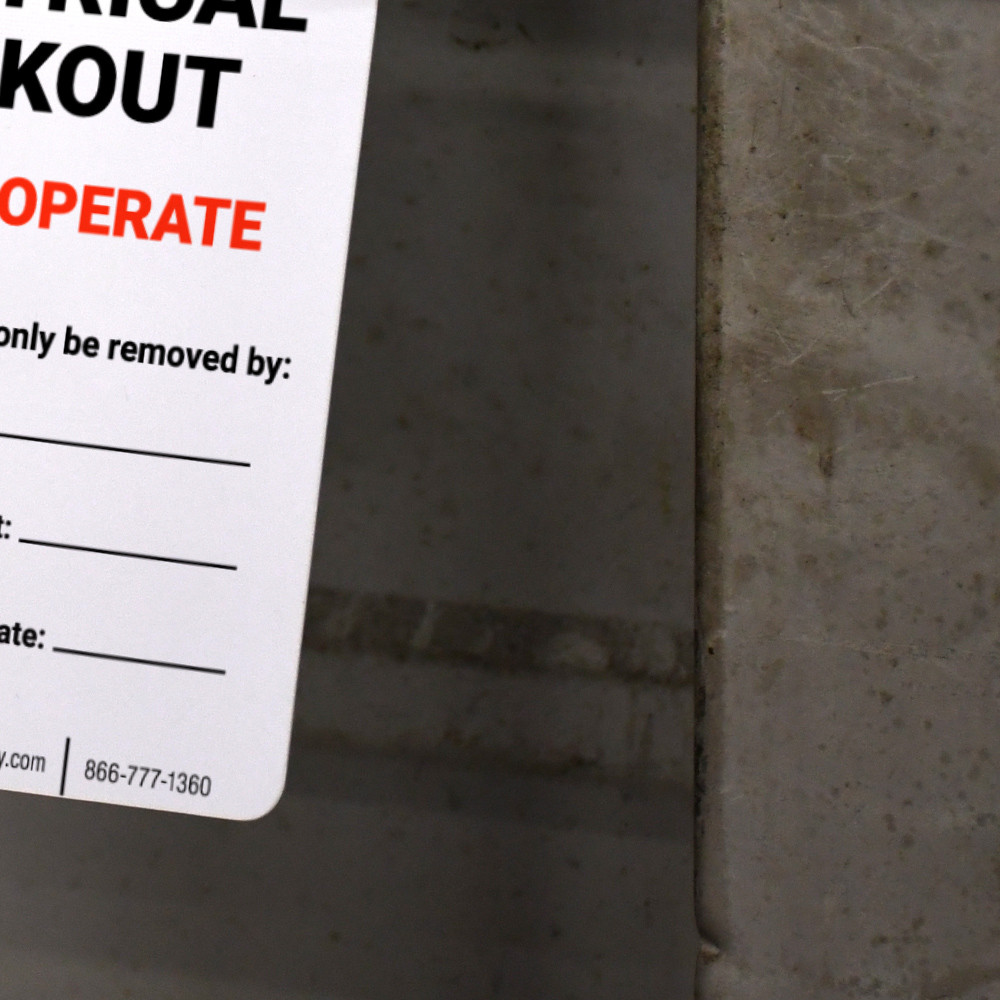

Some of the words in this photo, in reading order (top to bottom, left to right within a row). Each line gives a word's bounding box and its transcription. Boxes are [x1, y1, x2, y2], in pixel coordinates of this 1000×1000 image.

[63, 326, 100, 359] be
[108, 338, 239, 374] removed
[247, 346, 291, 385] by:
[84, 758, 212, 797] 866-777-1360
